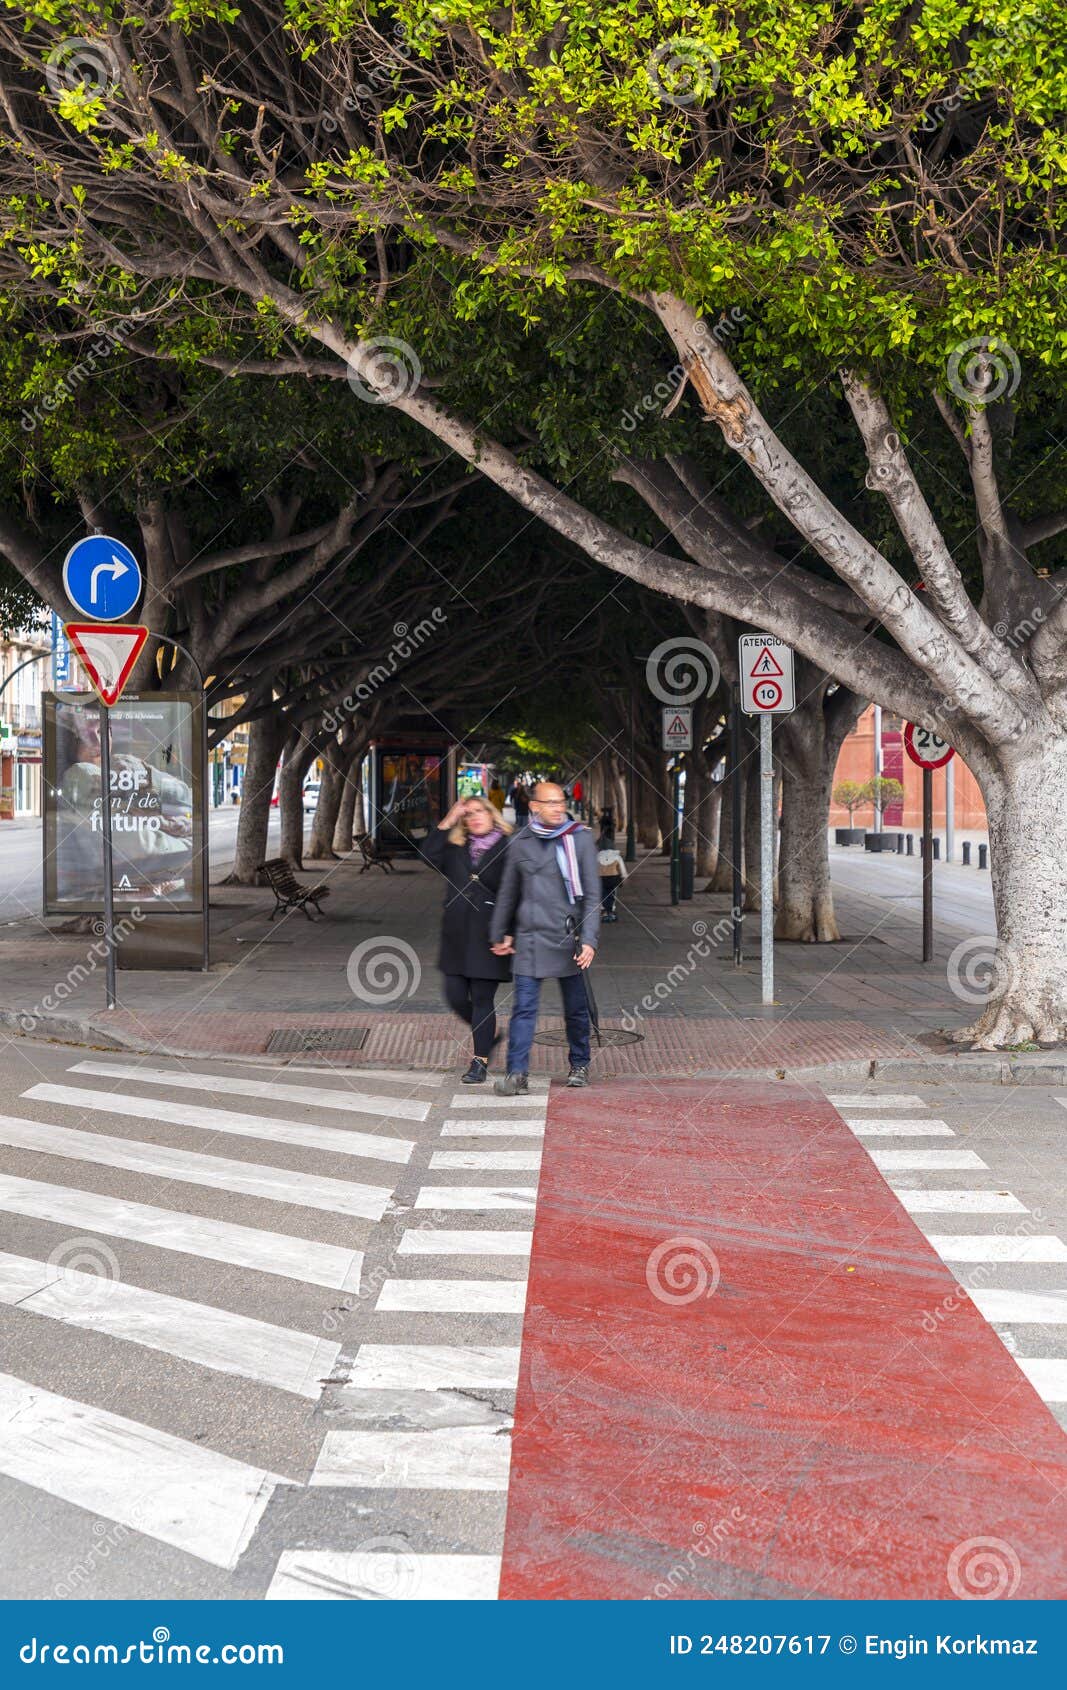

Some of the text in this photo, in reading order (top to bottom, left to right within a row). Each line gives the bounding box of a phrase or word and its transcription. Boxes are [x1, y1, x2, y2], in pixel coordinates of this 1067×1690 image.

[743, 638, 786, 646] ATENCIO
[761, 689, 775, 699] 10
[110, 770, 148, 790] 28F
[93, 797, 121, 808] cn
[138, 792, 157, 808] de
